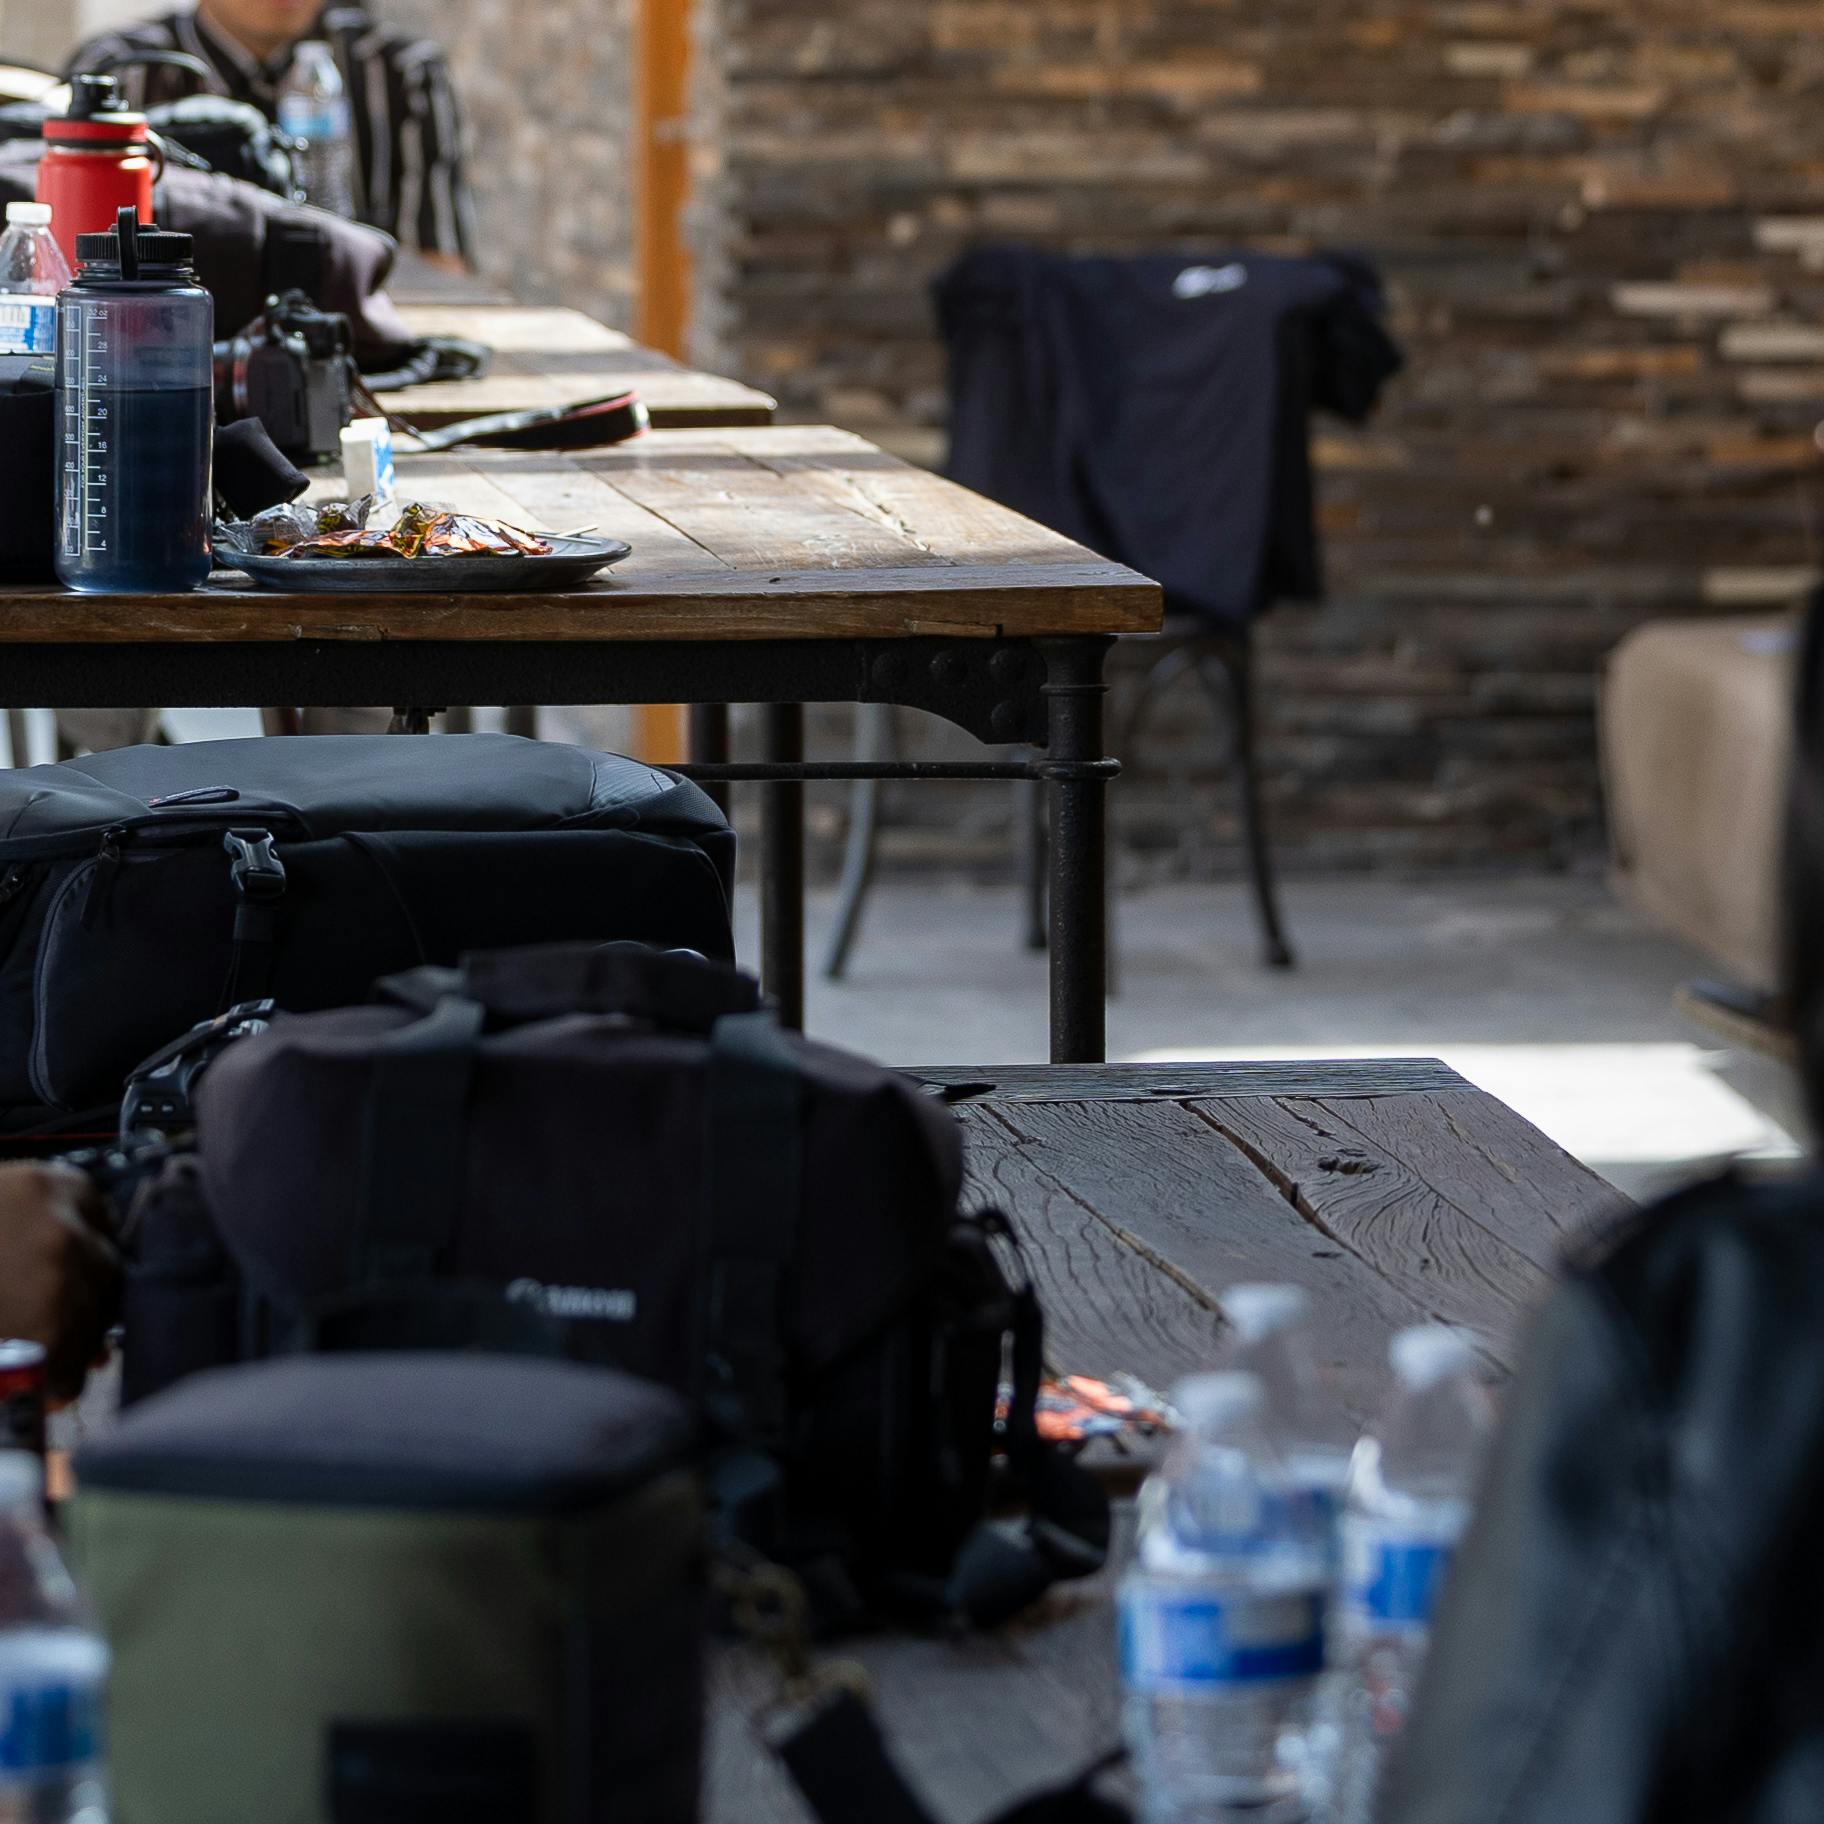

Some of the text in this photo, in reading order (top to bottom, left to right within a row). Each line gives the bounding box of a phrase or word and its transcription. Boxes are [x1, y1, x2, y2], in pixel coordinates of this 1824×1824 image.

[97, 374, 107, 383] 24
[97, 407, 108, 416] 20
[97, 474, 107, 482] 12
